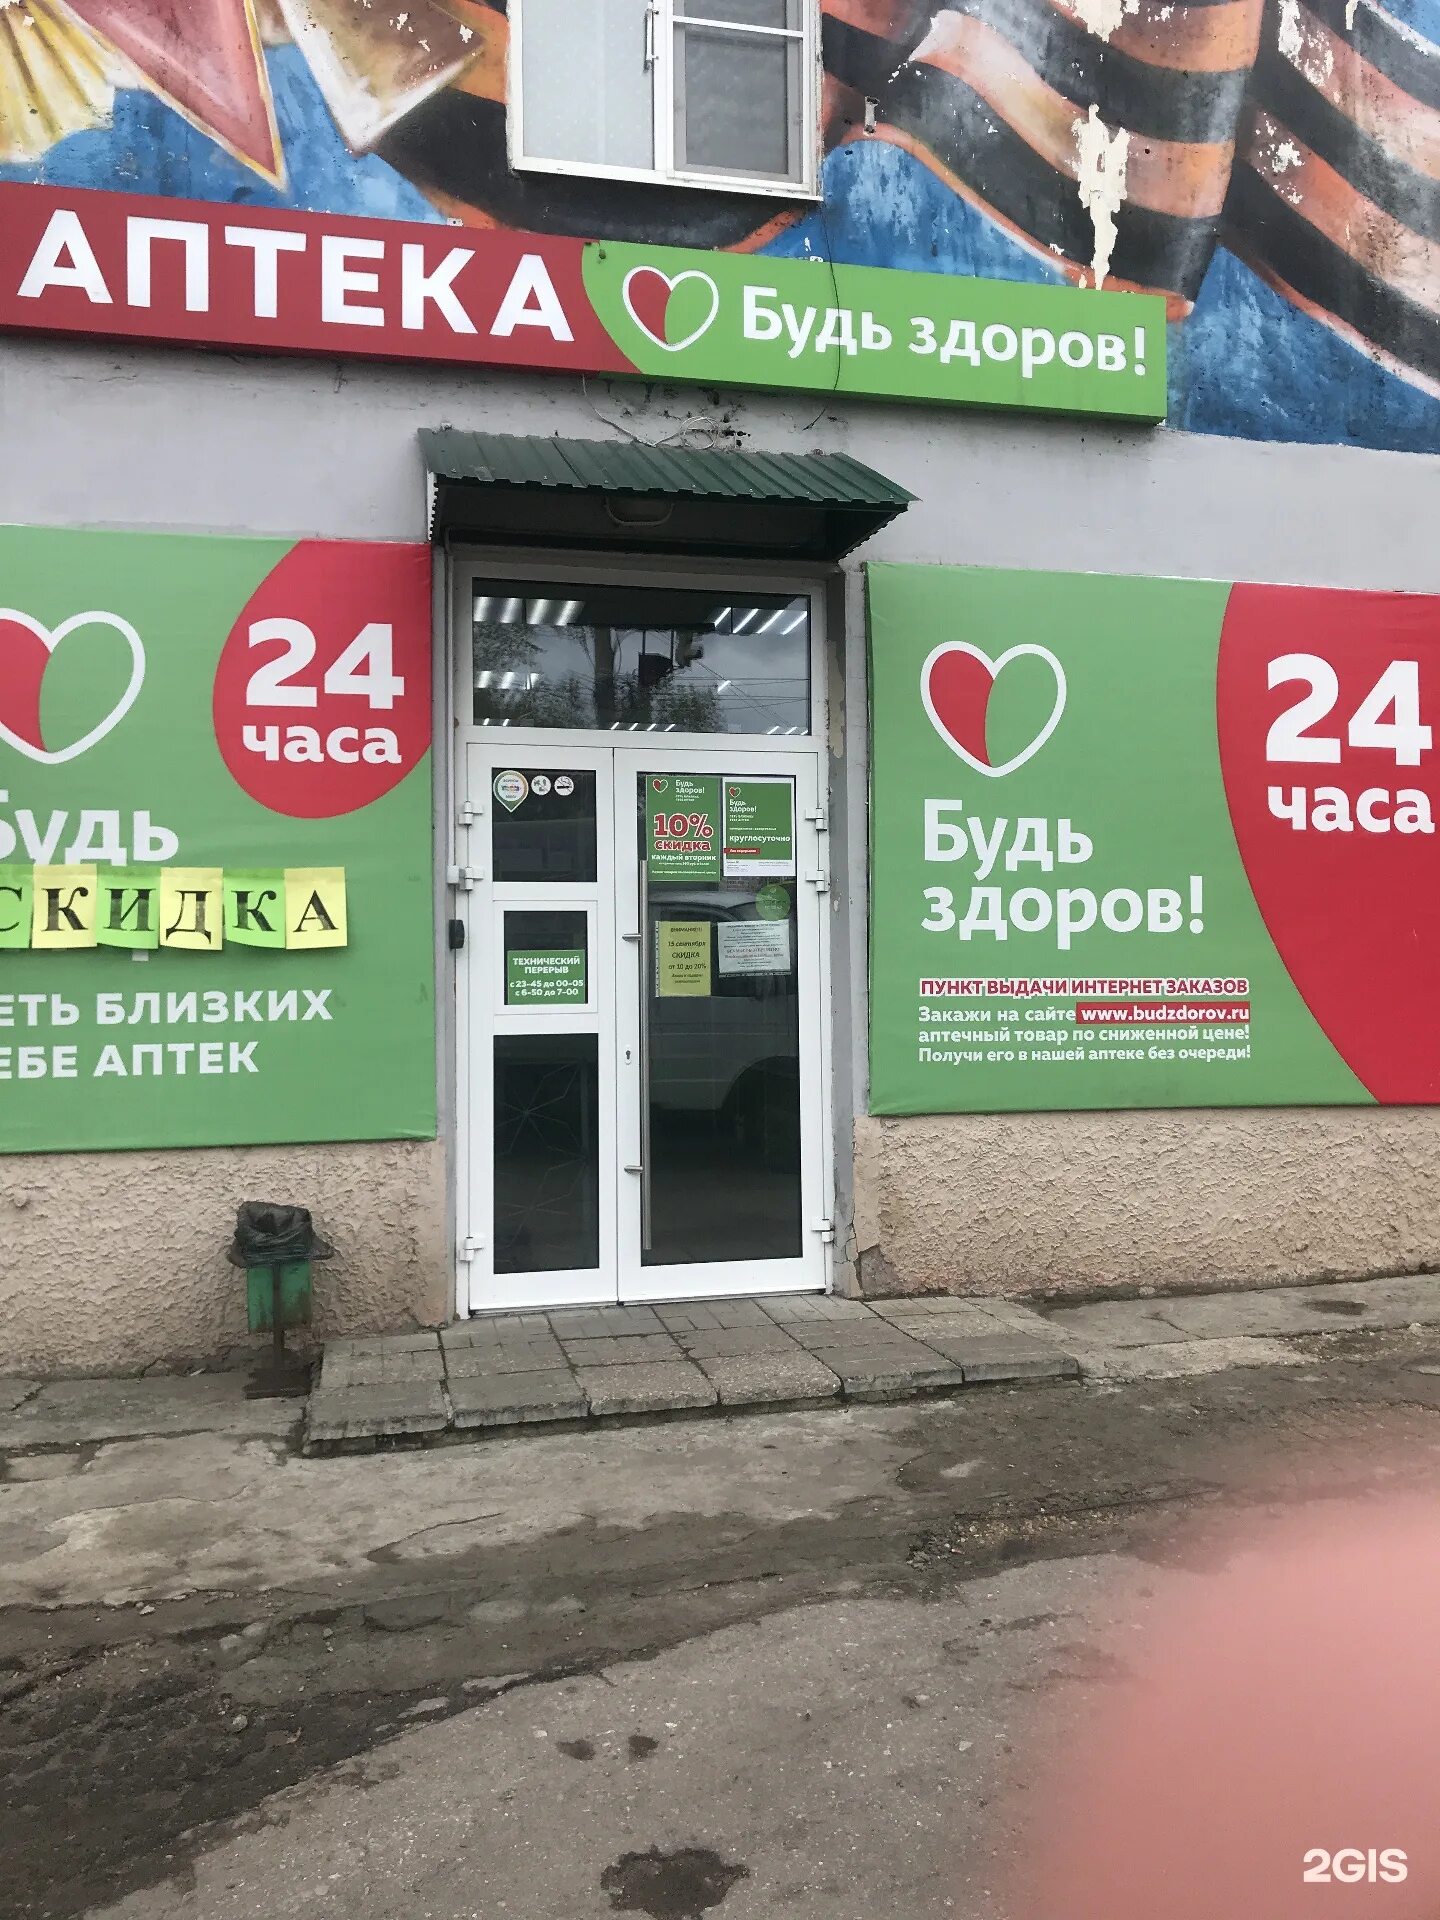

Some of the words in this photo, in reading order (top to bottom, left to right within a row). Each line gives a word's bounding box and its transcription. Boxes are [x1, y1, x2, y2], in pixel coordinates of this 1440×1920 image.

[17, 208, 574, 341] АПТЕКА
[742, 285, 892, 358] Будь
[908, 315, 1147, 378] здоров!
[246, 617, 405, 709] 24
[1266, 653, 1433, 766] 24
[242, 725, 402, 763] часа
[1267, 786, 1436, 834] часа
[653, 812, 714, 838] 10%
[654, 840, 712, 853] скидка
[729, 835, 791, 843] круглосуточно
[924, 798, 1093, 881] Будь
[651, 853, 684, 861] каждый
[921, 875, 1204, 950] здоров!
[512, 955, 581, 965] ТЕХНИЧЕСКИЙ
[671, 951, 700, 959] СКИДКА
[524, 966, 569, 974] ПЕРЕРЫВ
[920, 978, 984, 996] ПУНКТ
[985, 978, 1069, 998] ВЫДАЧИ
[1070, 978, 1163, 996] ИНТЕРНЕТ
[1165, 978, 1250, 996] ЗАКАЗОВ
[96, 989, 334, 1025] БЛИЗКИХ
[918, 1006, 991, 1022] Закажи
[997, 1009, 1020, 1022] на
[1024, 1006, 1076, 1022] сайте
[1081, 1005, 1249, 1021] www.budzdorov.ru
[918, 1026, 1010, 1042] аптечный
[1014, 1029, 1068, 1045] товар
[1072, 1029, 1095, 1041] по
[1098, 1025, 1199, 1041] сниженной
[1202, 1024, 1250, 1042] цене!
[93, 1041, 259, 1077] АПТЕК
[918, 1047, 983, 1066] Получи
[986, 1050, 1015, 1062] его
[1018, 1050, 1028, 1061] в
[1031, 1047, 1085, 1061] нашей
[1088, 1048, 1145, 1060] аптеке
[1147, 1045, 1175, 1060] без
[1178, 1044, 1251, 1063] очереди!
